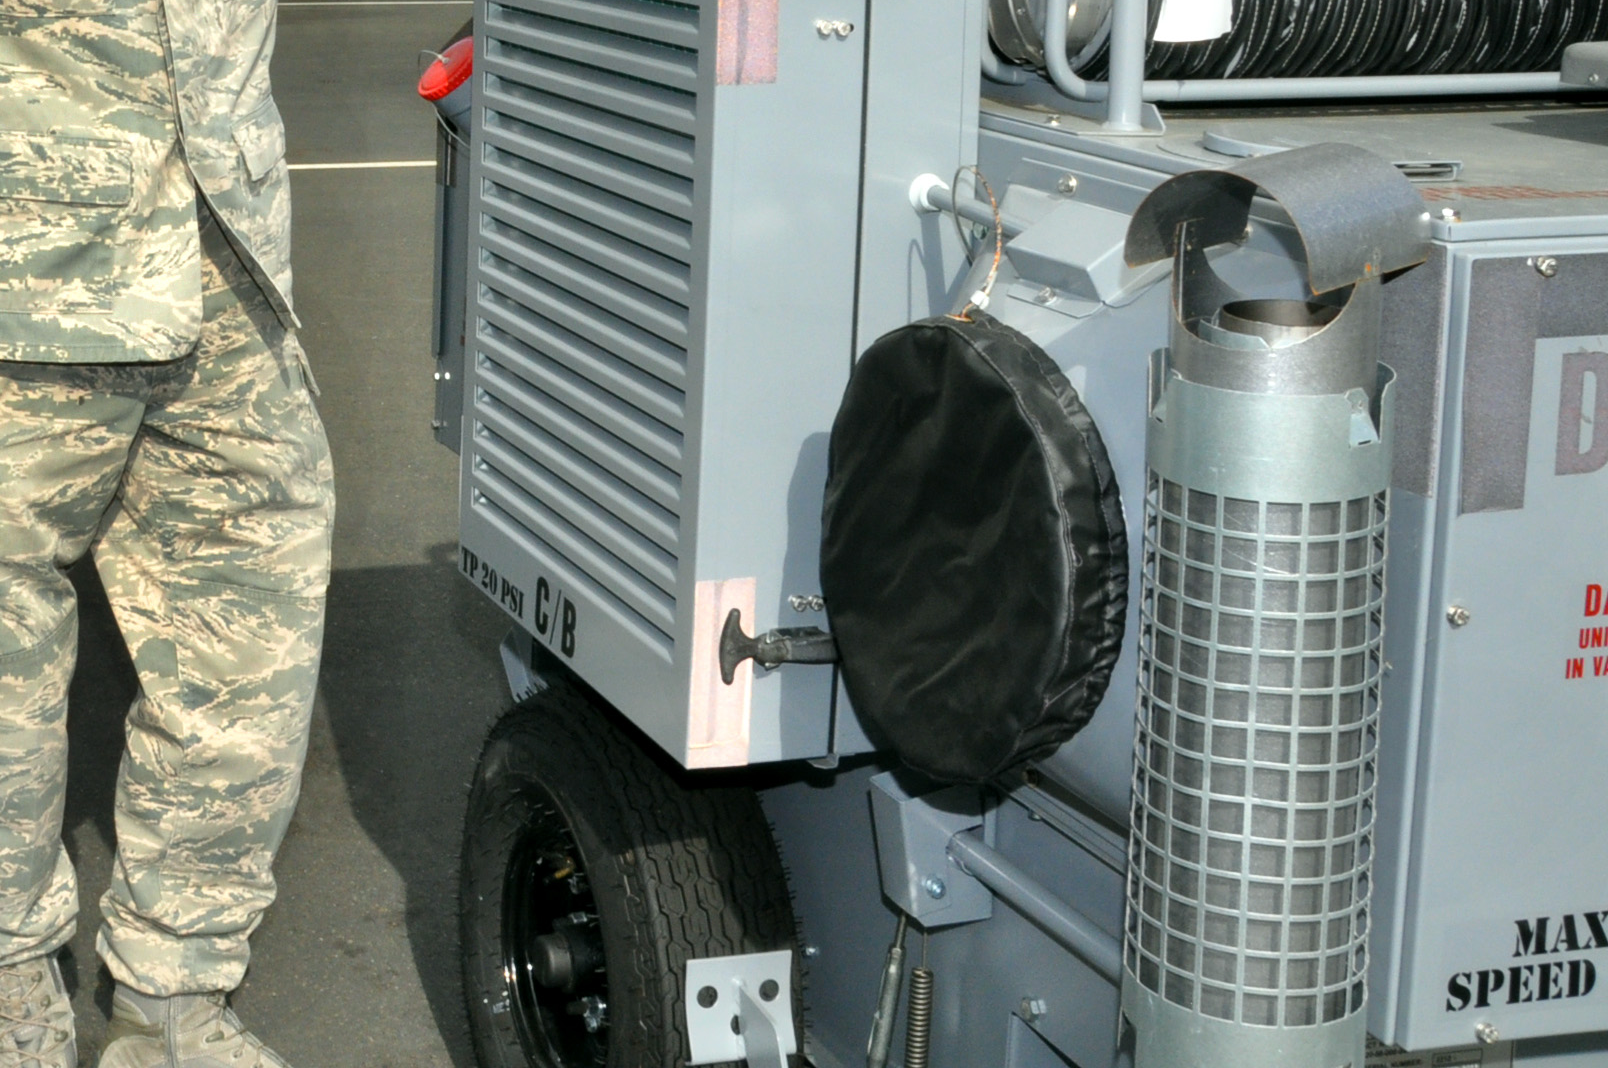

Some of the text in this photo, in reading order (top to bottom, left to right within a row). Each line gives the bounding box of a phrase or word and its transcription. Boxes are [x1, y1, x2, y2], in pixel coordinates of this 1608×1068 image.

[461, 545, 524, 619] TP 20 PSI
[535, 576, 576, 659] C/B
[1565, 658, 1584, 679] IN
[1512, 910, 1608, 957] MAX
[1446, 959, 1596, 1012] SPEED
